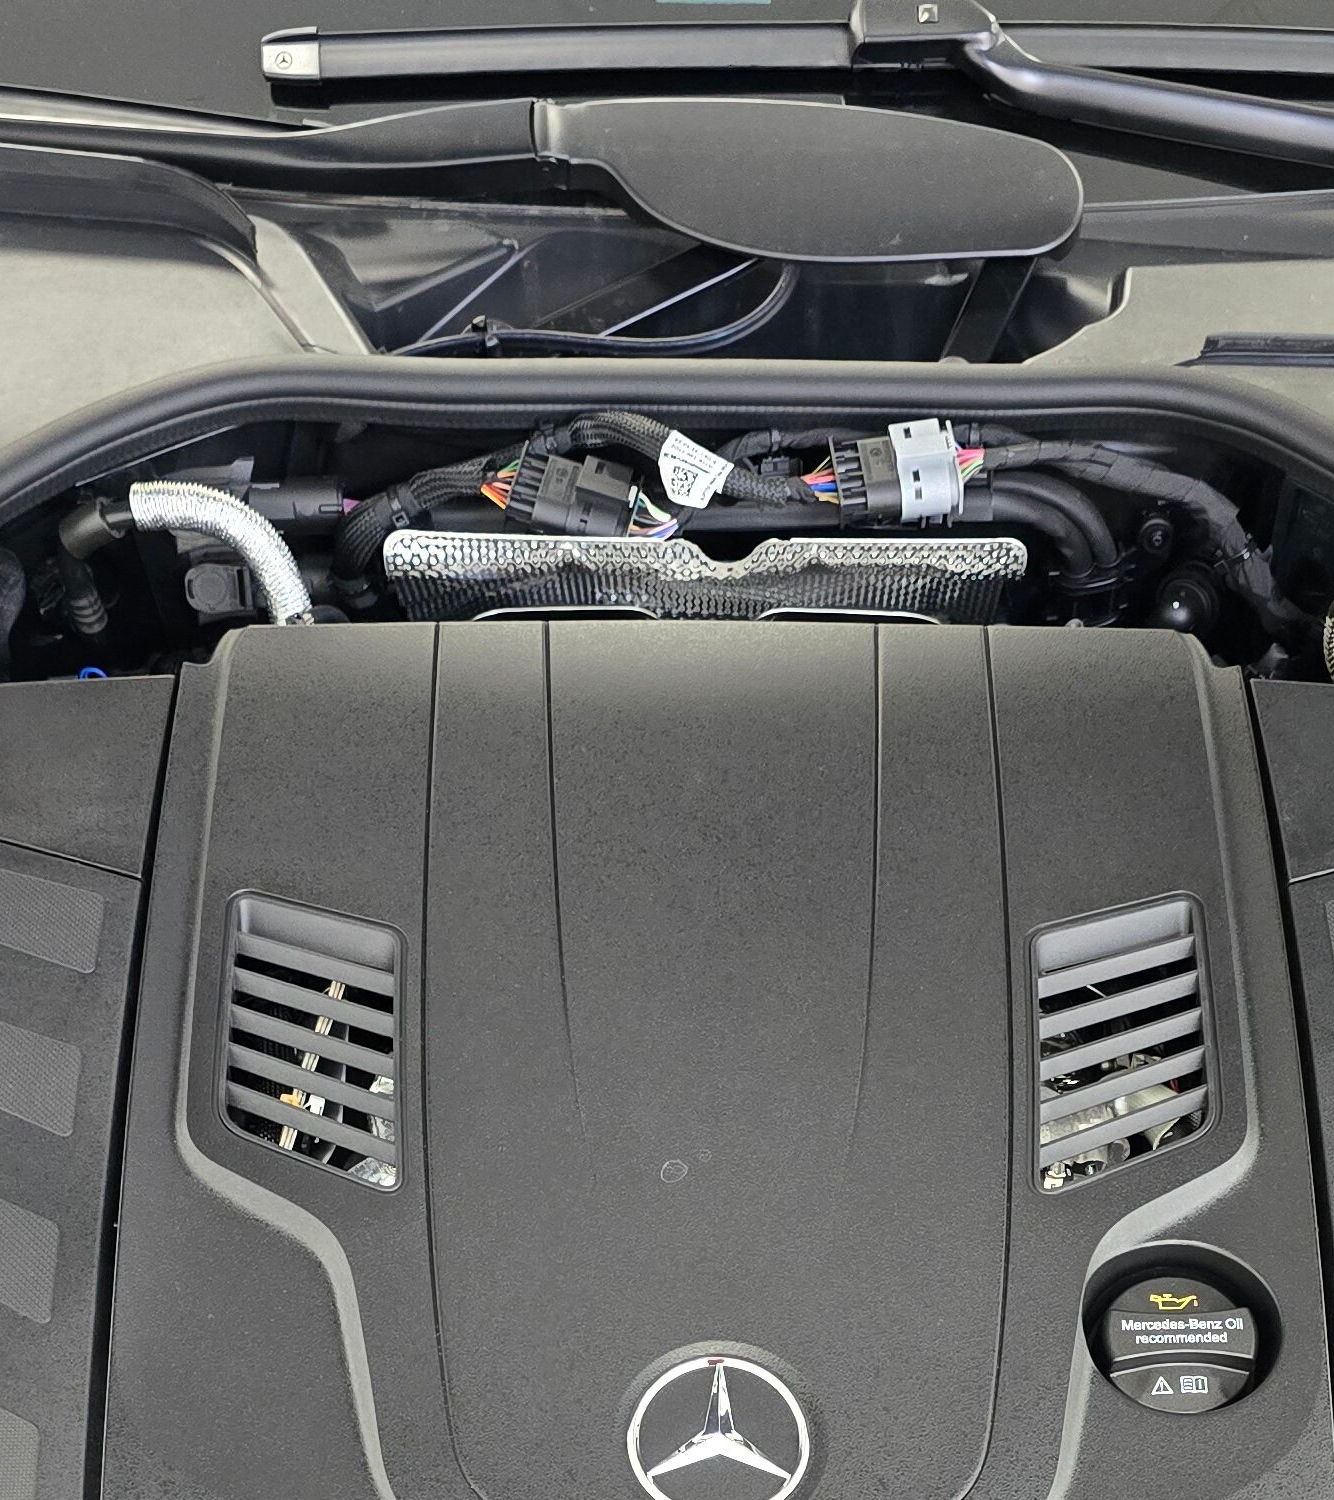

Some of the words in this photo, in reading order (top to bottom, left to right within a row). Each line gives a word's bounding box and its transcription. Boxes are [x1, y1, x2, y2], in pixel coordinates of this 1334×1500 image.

[1121, 1319, 1223, 1331] Mercedes-Benz
[1224, 1317, 1244, 1330] Oil
[1135, 1331, 1228, 1344] recommended
